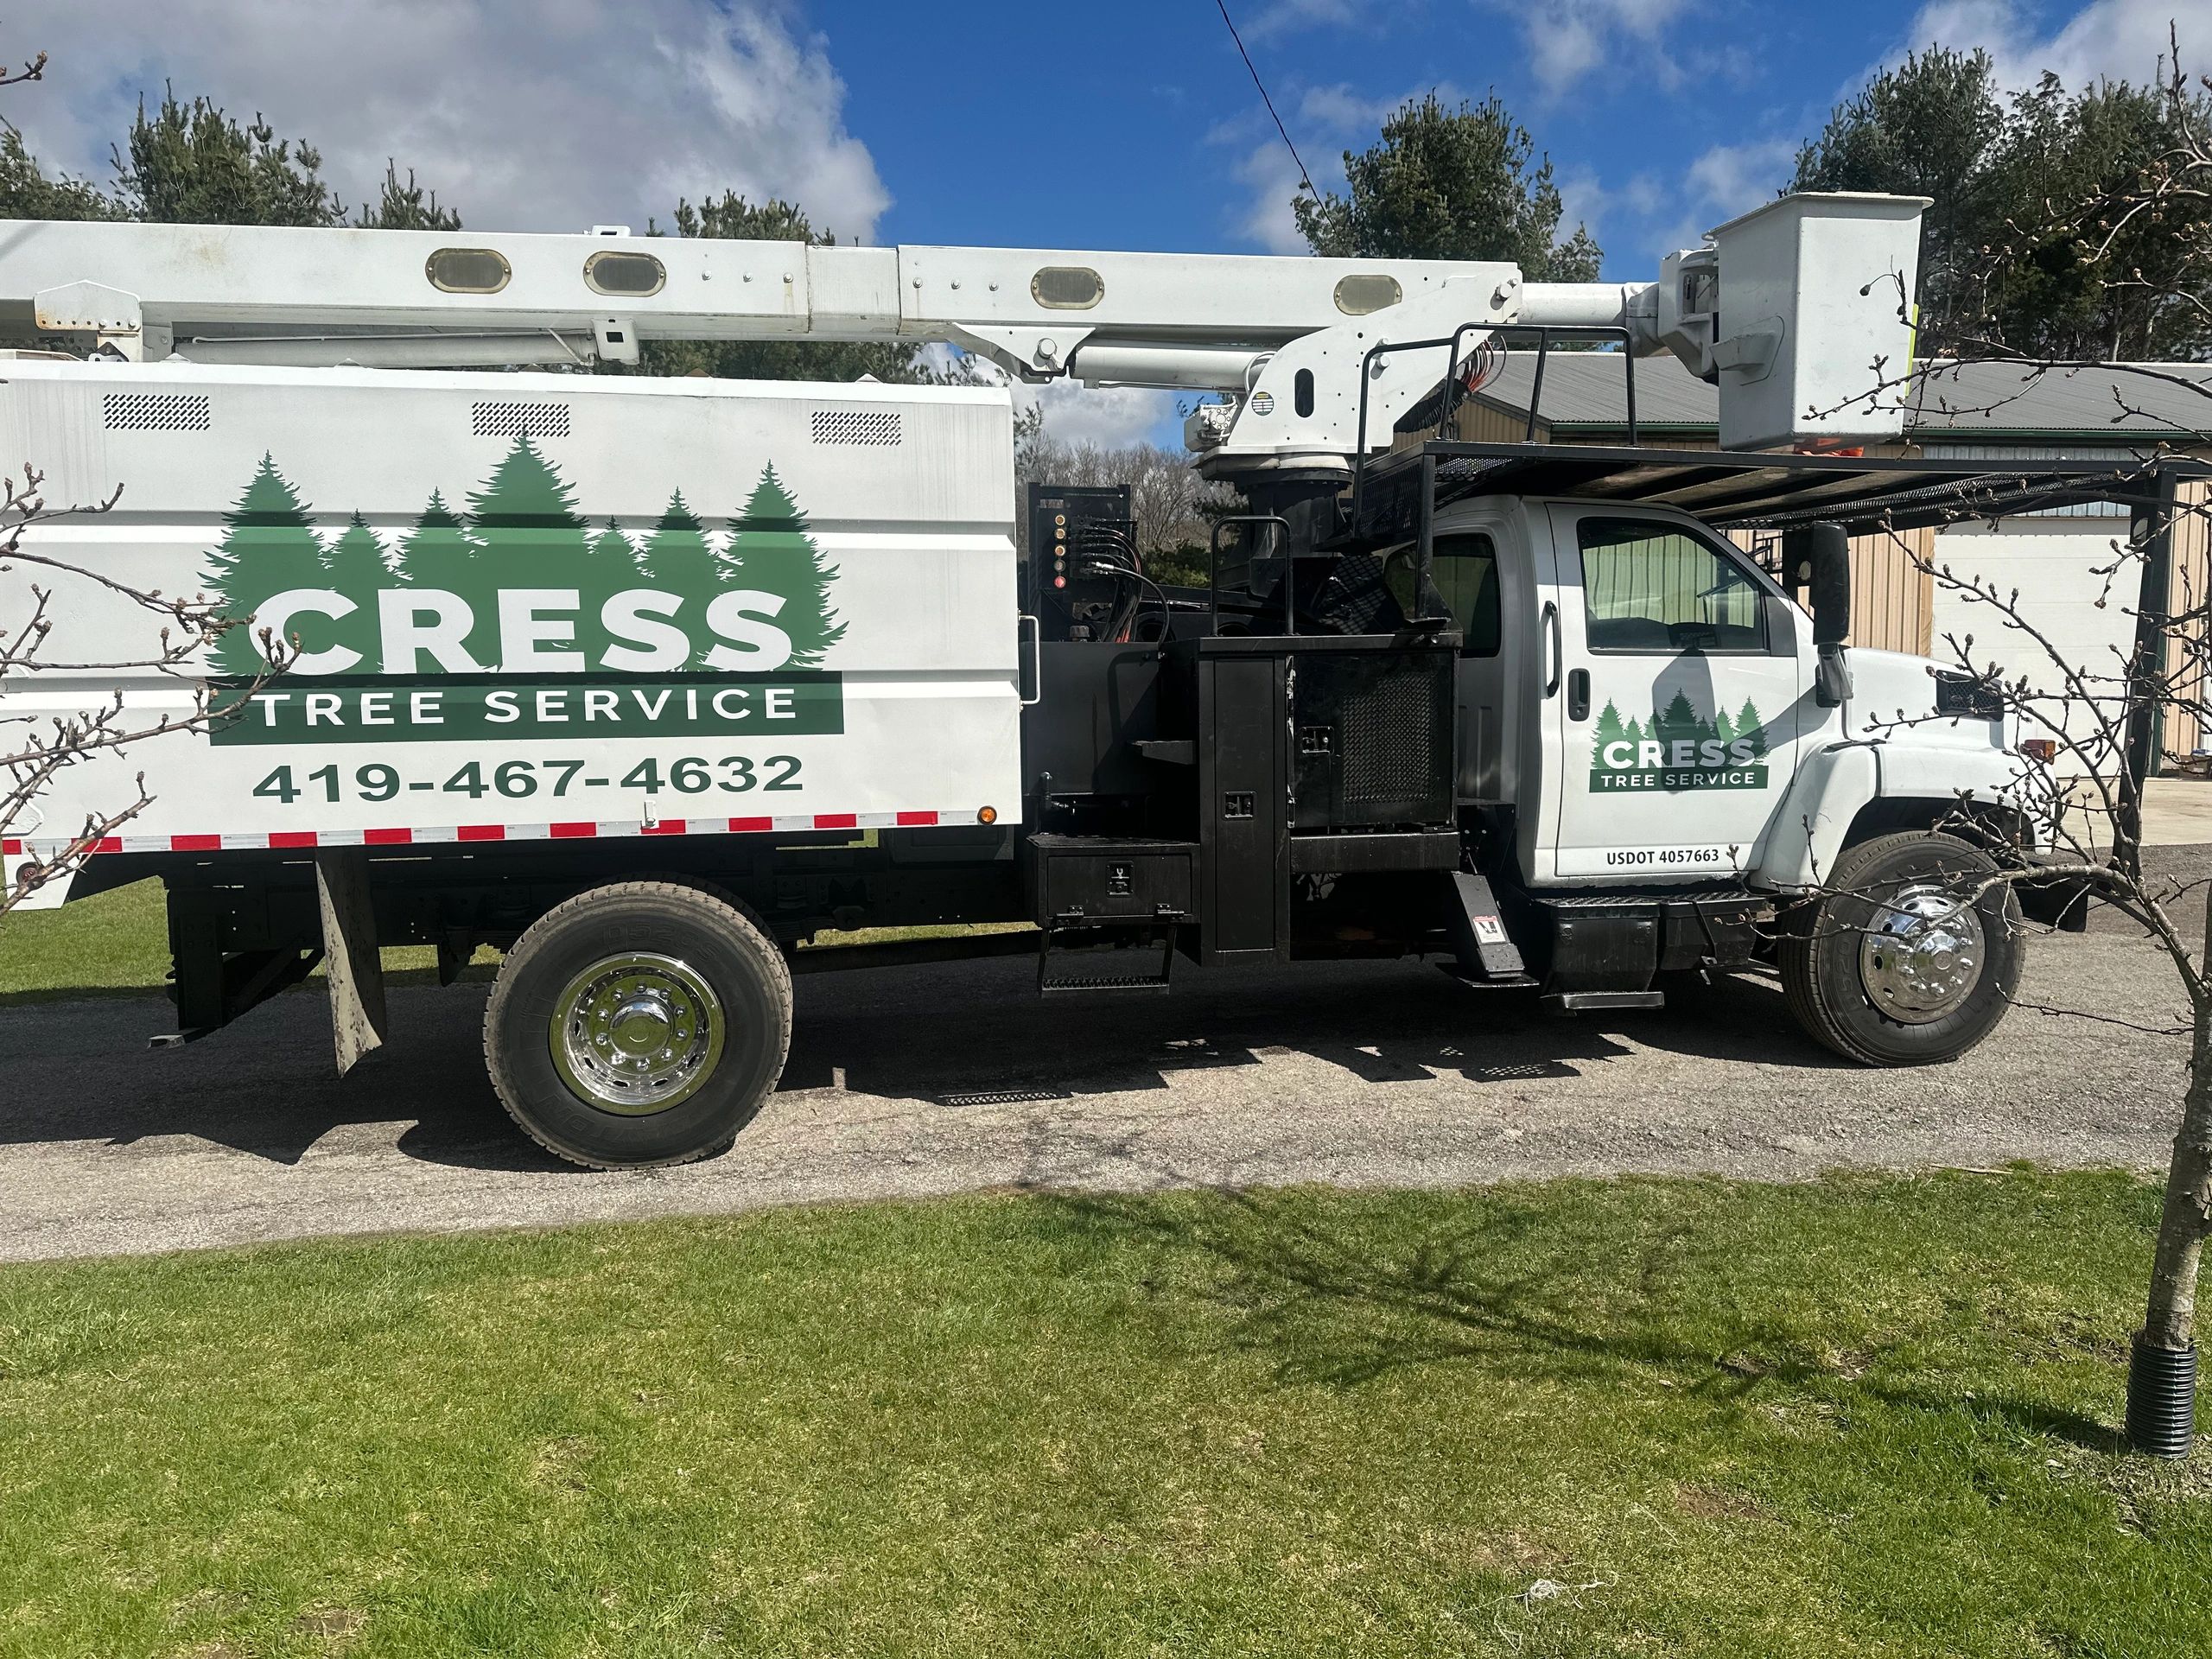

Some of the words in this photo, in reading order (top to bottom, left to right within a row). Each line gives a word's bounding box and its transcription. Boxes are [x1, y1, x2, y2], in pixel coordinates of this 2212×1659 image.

[249, 588, 792, 676] CRESS
[251, 691, 444, 727] TREE
[484, 689, 797, 723] SERVICE
[1603, 740, 1756, 770] CRESS
[253, 755, 804, 804] 419-467-4632
[1601, 774, 1656, 787] TREE
[1665, 772, 1755, 786] SERVICE
[1607, 851, 1655, 865] USDOT
[1659, 849, 1719, 863] 4057663
